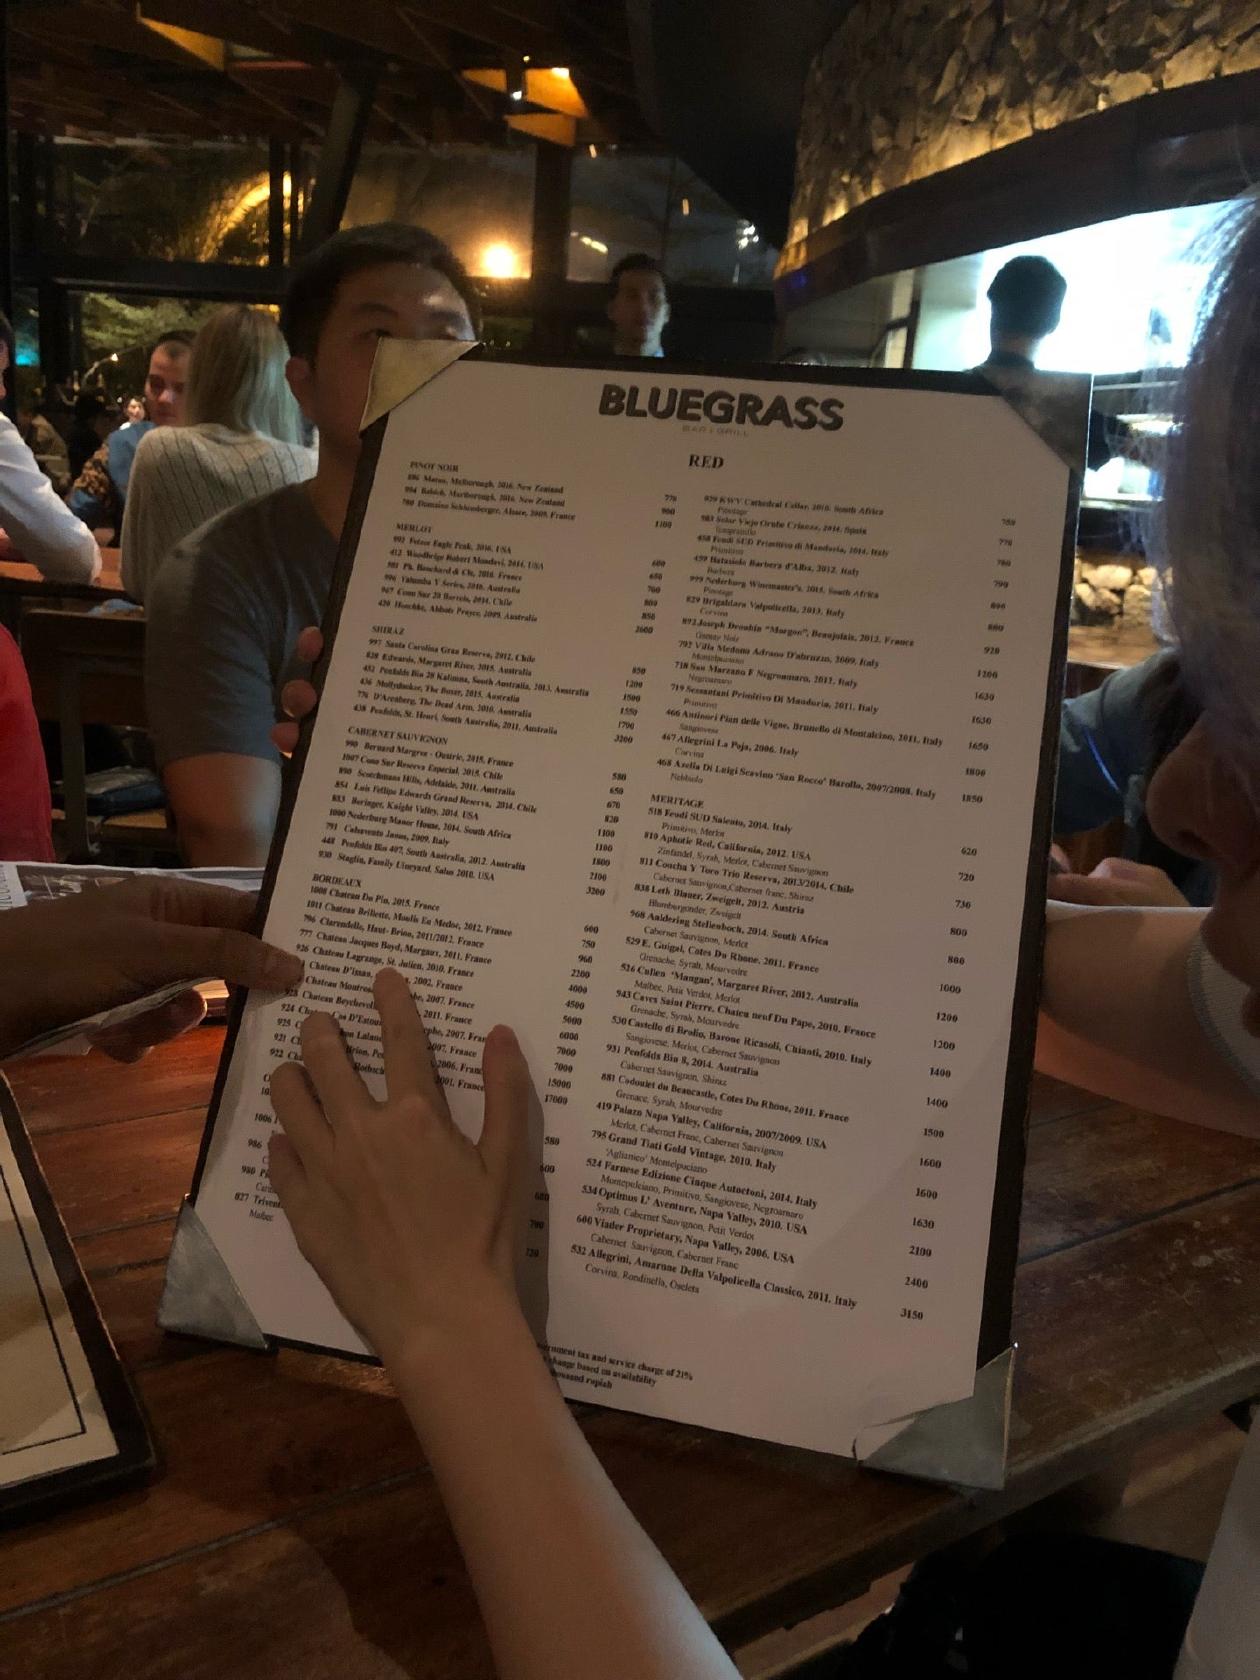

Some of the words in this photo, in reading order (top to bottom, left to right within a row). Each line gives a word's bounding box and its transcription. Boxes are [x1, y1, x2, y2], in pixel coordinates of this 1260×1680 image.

[598, 383, 844, 431] BLUEGRASS
[688, 454, 724, 469] RED
[396, 522, 431, 533] MERLOT
[371, 625, 405, 635] SHIRAZ
[347, 726, 396, 739] CABERNET
[396, 731, 448, 745] SAUVIGNON
[650, 793, 704, 808] MERITAGE
[311, 873, 361, 888] BORDEAUX
[607, 1132, 638, 1146] Grand
[754, 1158, 776, 1173] Italy
[794, 1195, 817, 1209] Italy
